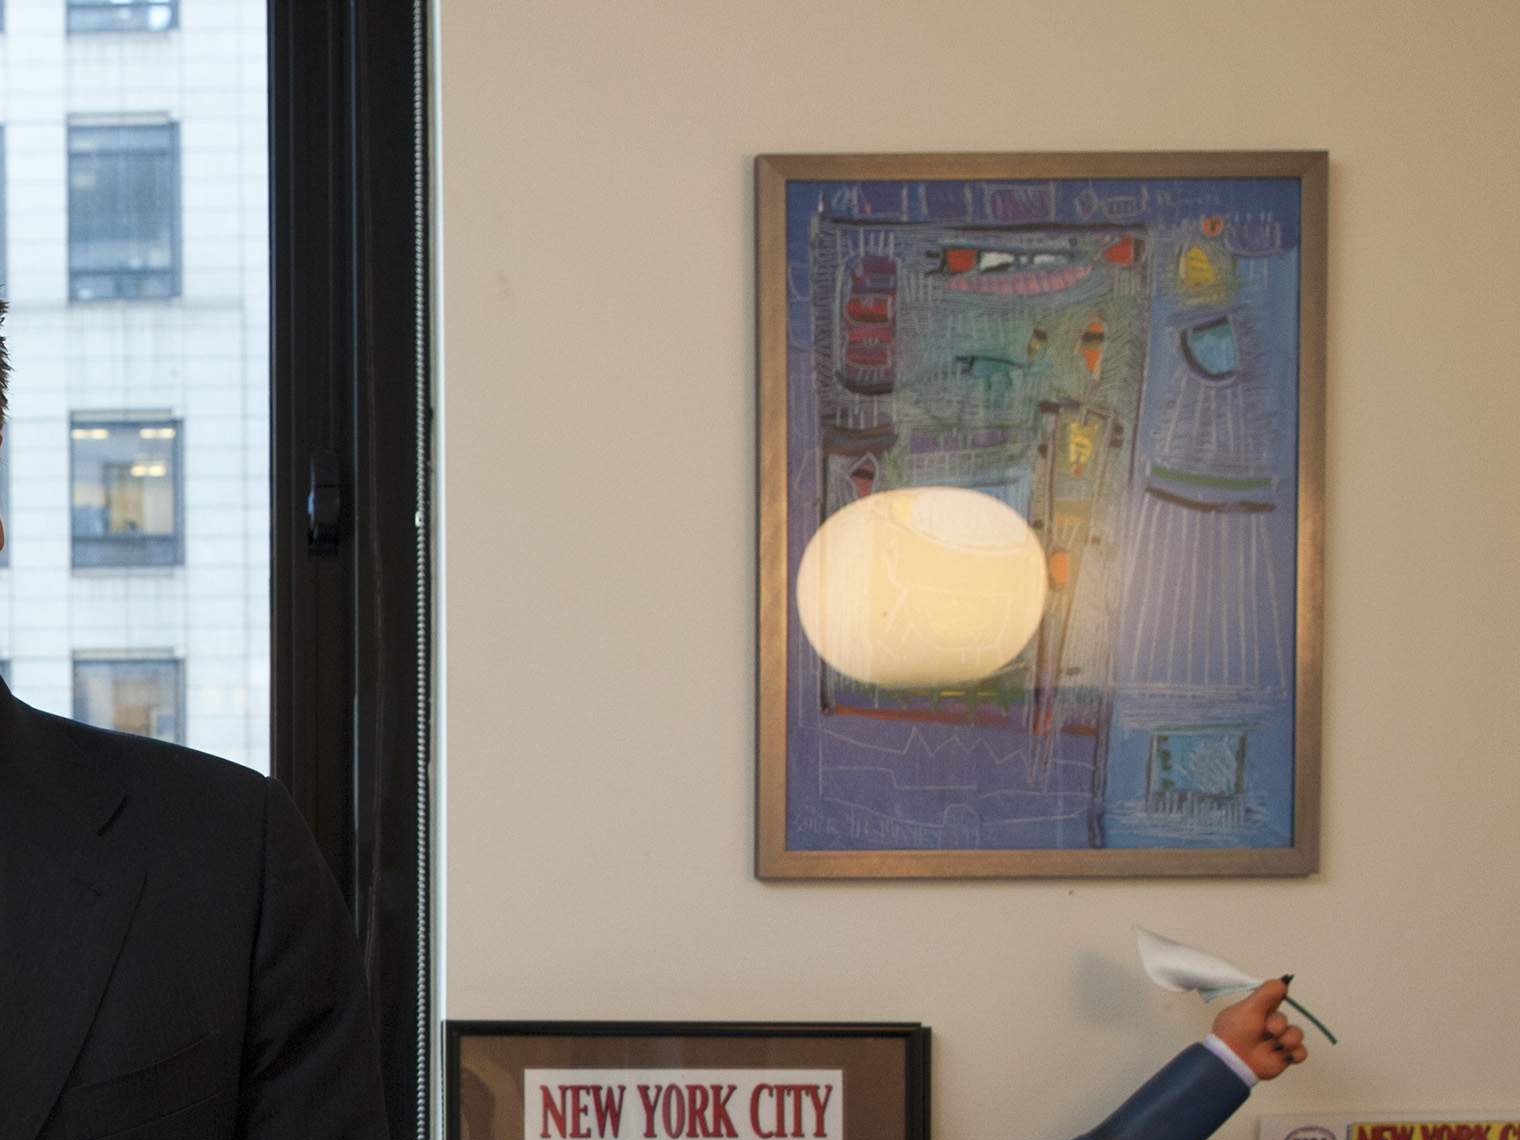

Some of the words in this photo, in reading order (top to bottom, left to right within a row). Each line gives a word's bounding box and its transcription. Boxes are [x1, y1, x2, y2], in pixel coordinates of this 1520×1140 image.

[539, 1083, 627, 1139] NEW
[636, 1083, 739, 1139] YORK
[749, 1082, 833, 1139] CITY
